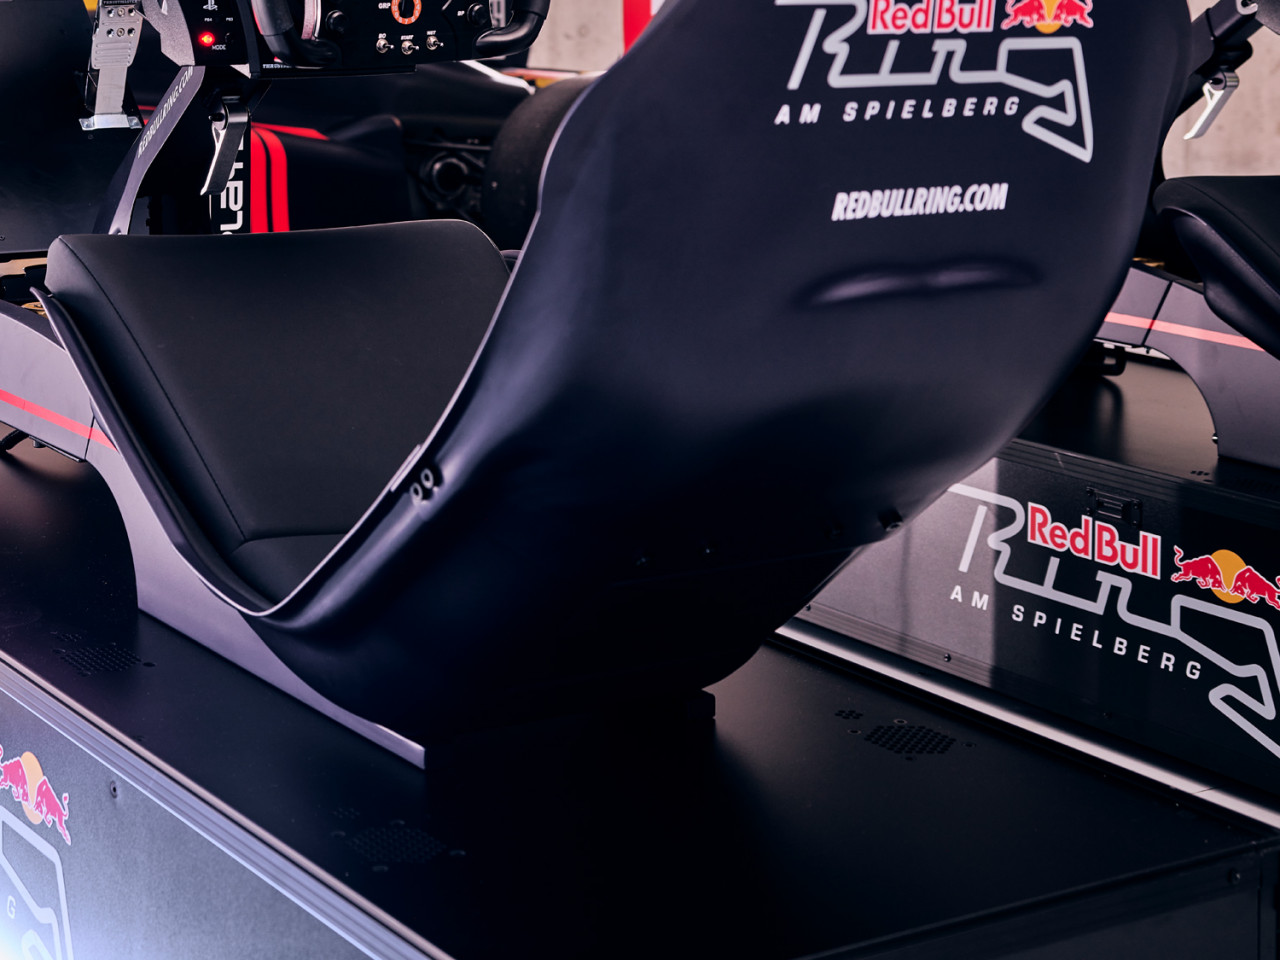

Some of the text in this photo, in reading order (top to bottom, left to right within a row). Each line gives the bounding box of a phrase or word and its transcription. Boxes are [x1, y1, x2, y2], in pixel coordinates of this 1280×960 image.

[137, 65, 194, 158] REDBULLRING.COM
[773, 95, 1021, 127] AM SPIELBERG
[831, 182, 1009, 223] REDBULLRING.COM
[1026, 501, 1163, 580] Red Bull
[950, 584, 1203, 681] AM SPIELBERG
